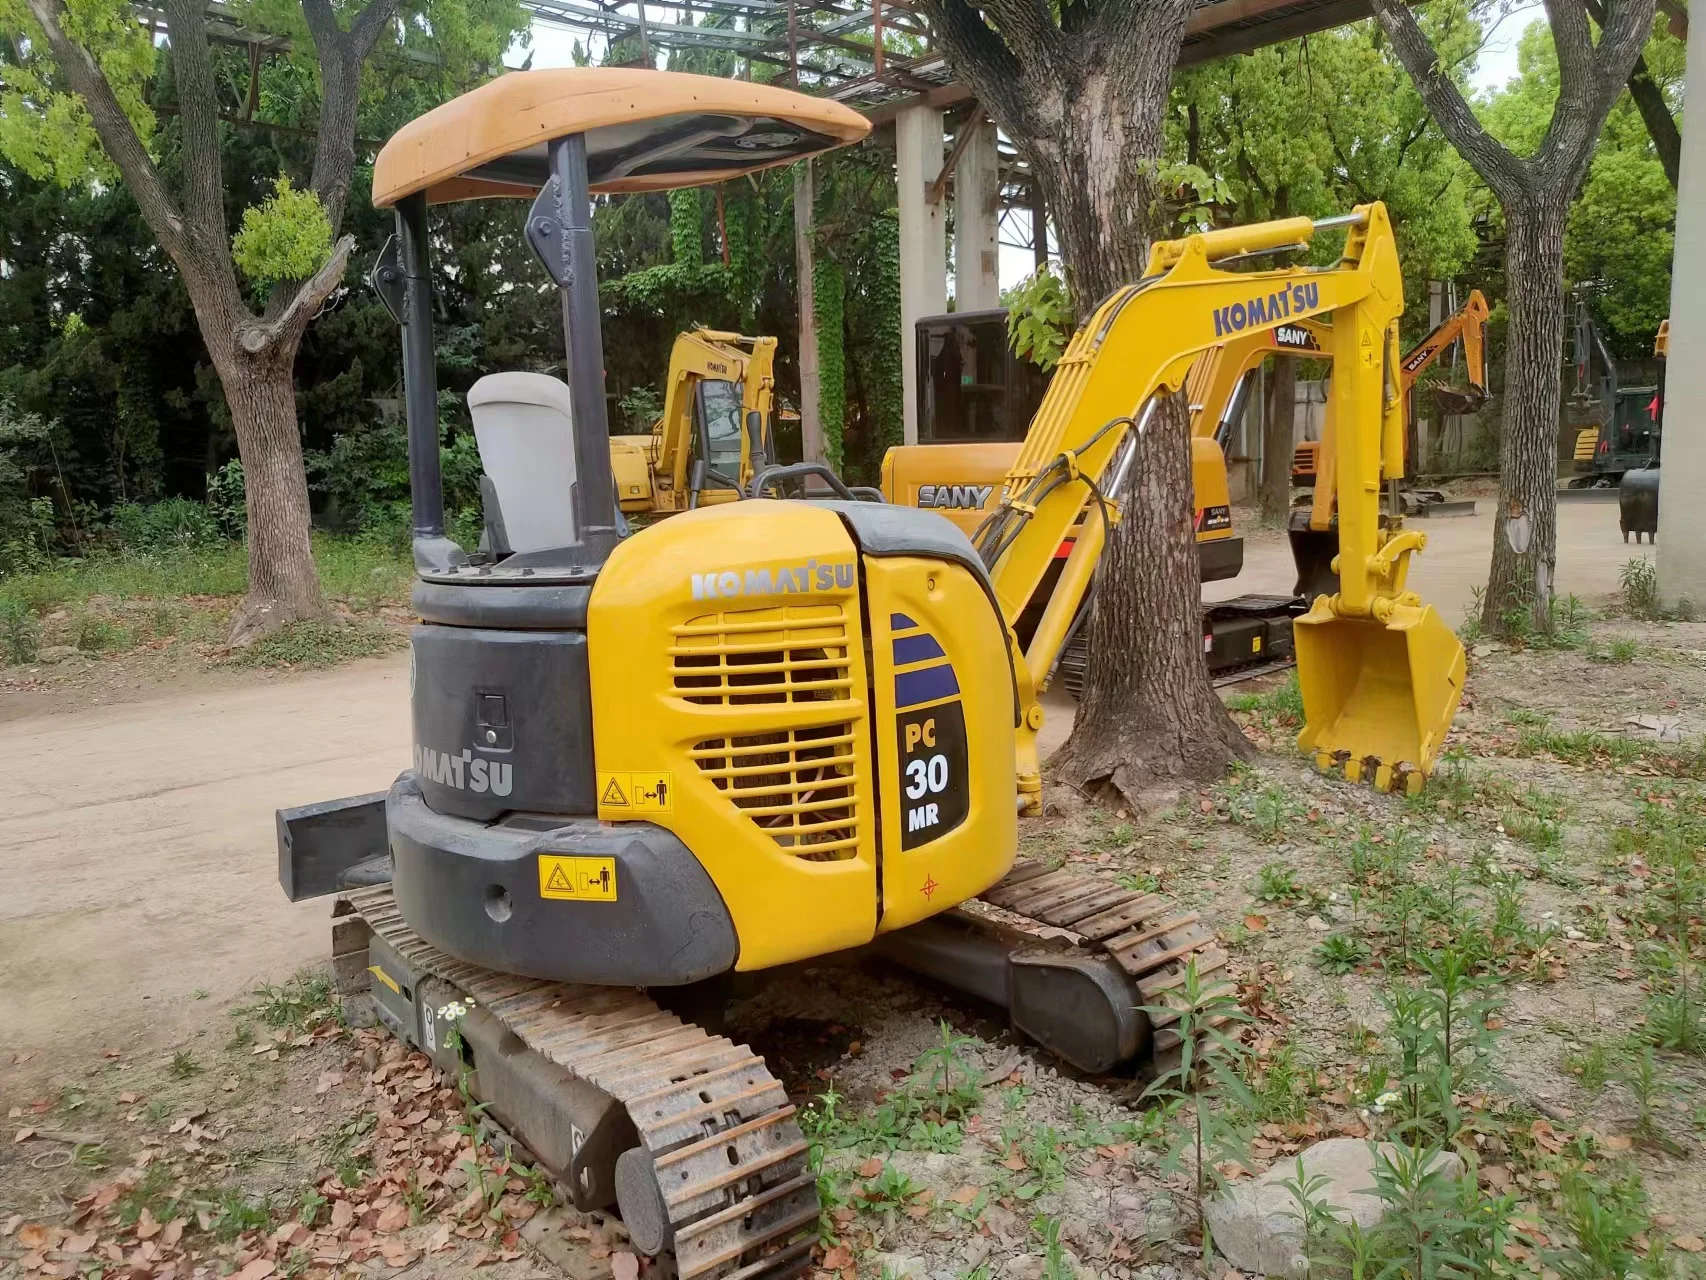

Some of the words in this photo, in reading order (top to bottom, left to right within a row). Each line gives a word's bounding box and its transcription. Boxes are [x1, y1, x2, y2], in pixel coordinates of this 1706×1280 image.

[1213, 281, 1318, 337] KOMATSU
[1277, 327, 1307, 345] SANY
[706, 361, 728, 374] KOMATSU
[1408, 350, 1428, 370] SANY
[918, 485, 995, 509] SANY
[691, 559, 854, 600] KOMATSU
[905, 718, 936, 753] PC
[414, 743, 513, 797] OMATSU
[905, 754, 949, 800] 30
[908, 802, 940, 832] MR
